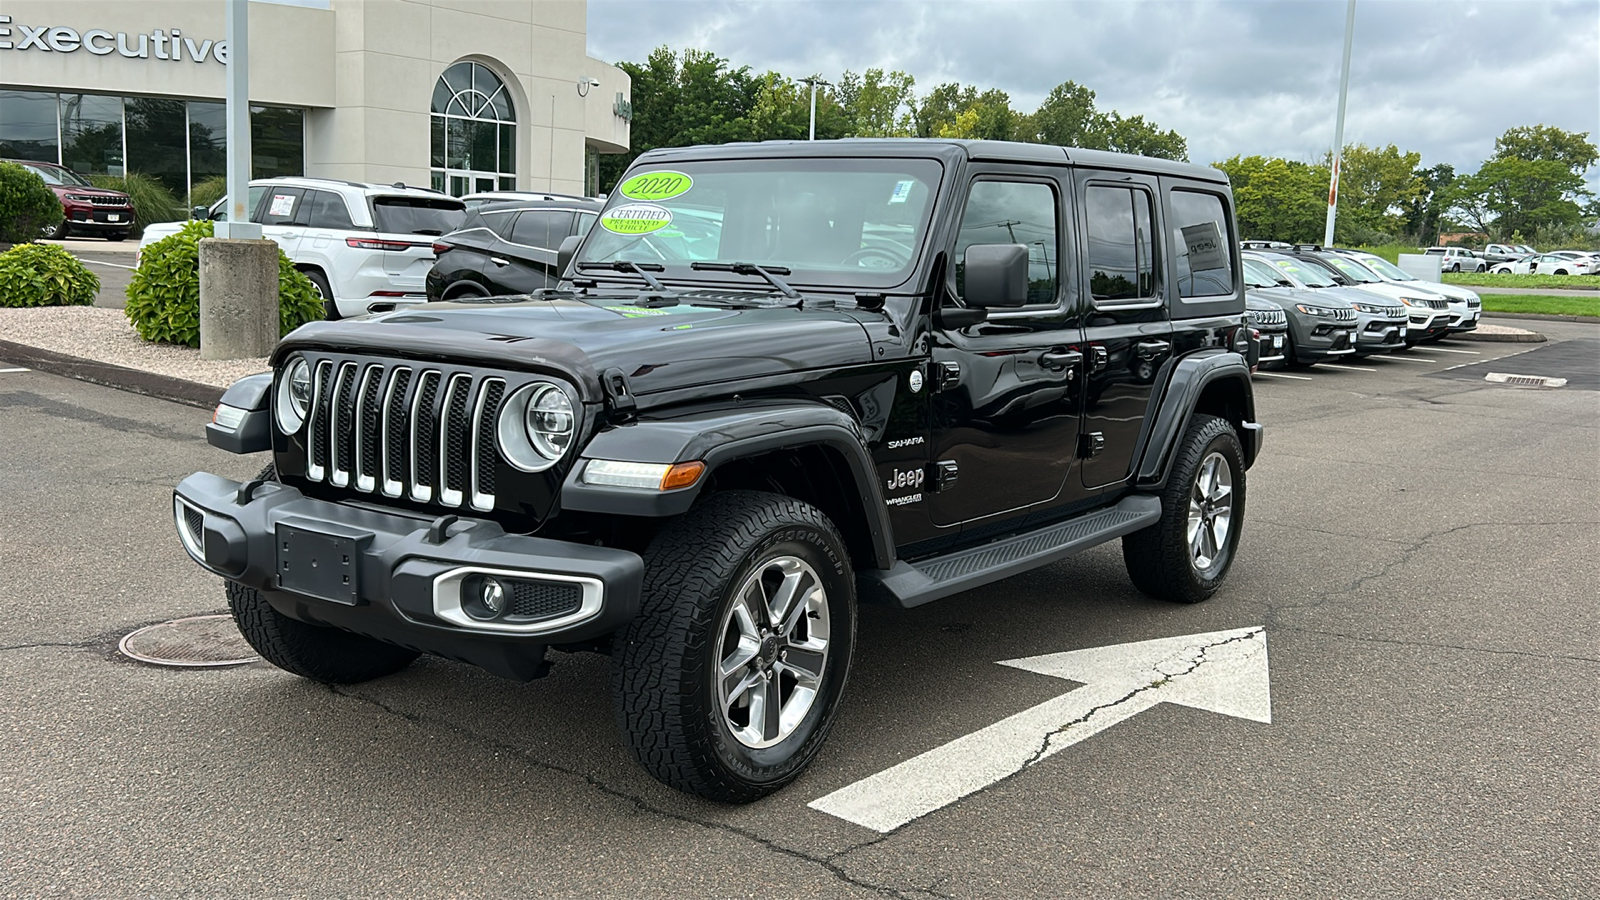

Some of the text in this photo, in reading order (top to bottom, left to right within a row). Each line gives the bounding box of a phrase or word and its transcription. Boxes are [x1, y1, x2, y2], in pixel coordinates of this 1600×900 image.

[628, 177, 683, 194] 2020
[611, 209, 667, 220] CERTIFIED
[887, 436, 925, 449] SAHARA
[887, 468, 925, 490] Jeep
[885, 493, 922, 505] WRANGLER
